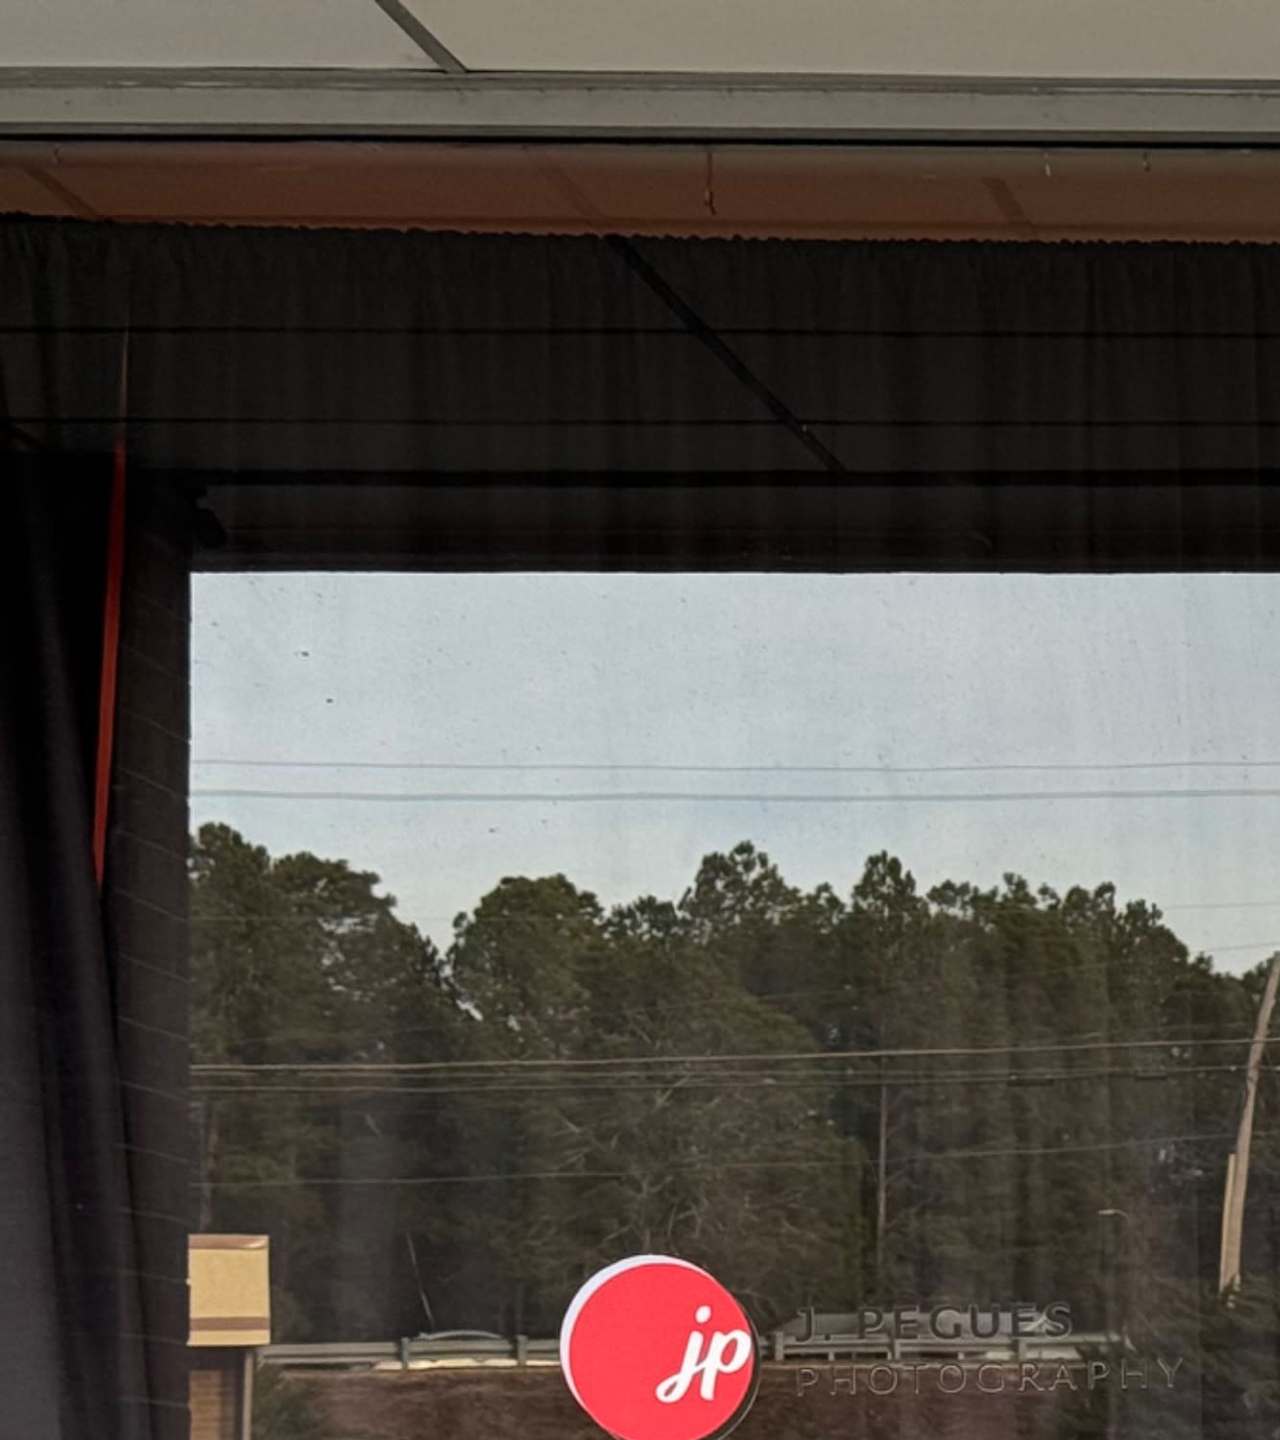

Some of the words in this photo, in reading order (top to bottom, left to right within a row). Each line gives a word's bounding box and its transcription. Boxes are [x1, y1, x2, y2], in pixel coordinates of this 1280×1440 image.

[795, 1306, 832, 1343] J.
[858, 1304, 1073, 1340] PEGUES
[655, 1304, 752, 1403] jp
[797, 1357, 1183, 1396] PHOTOGRAPHY
